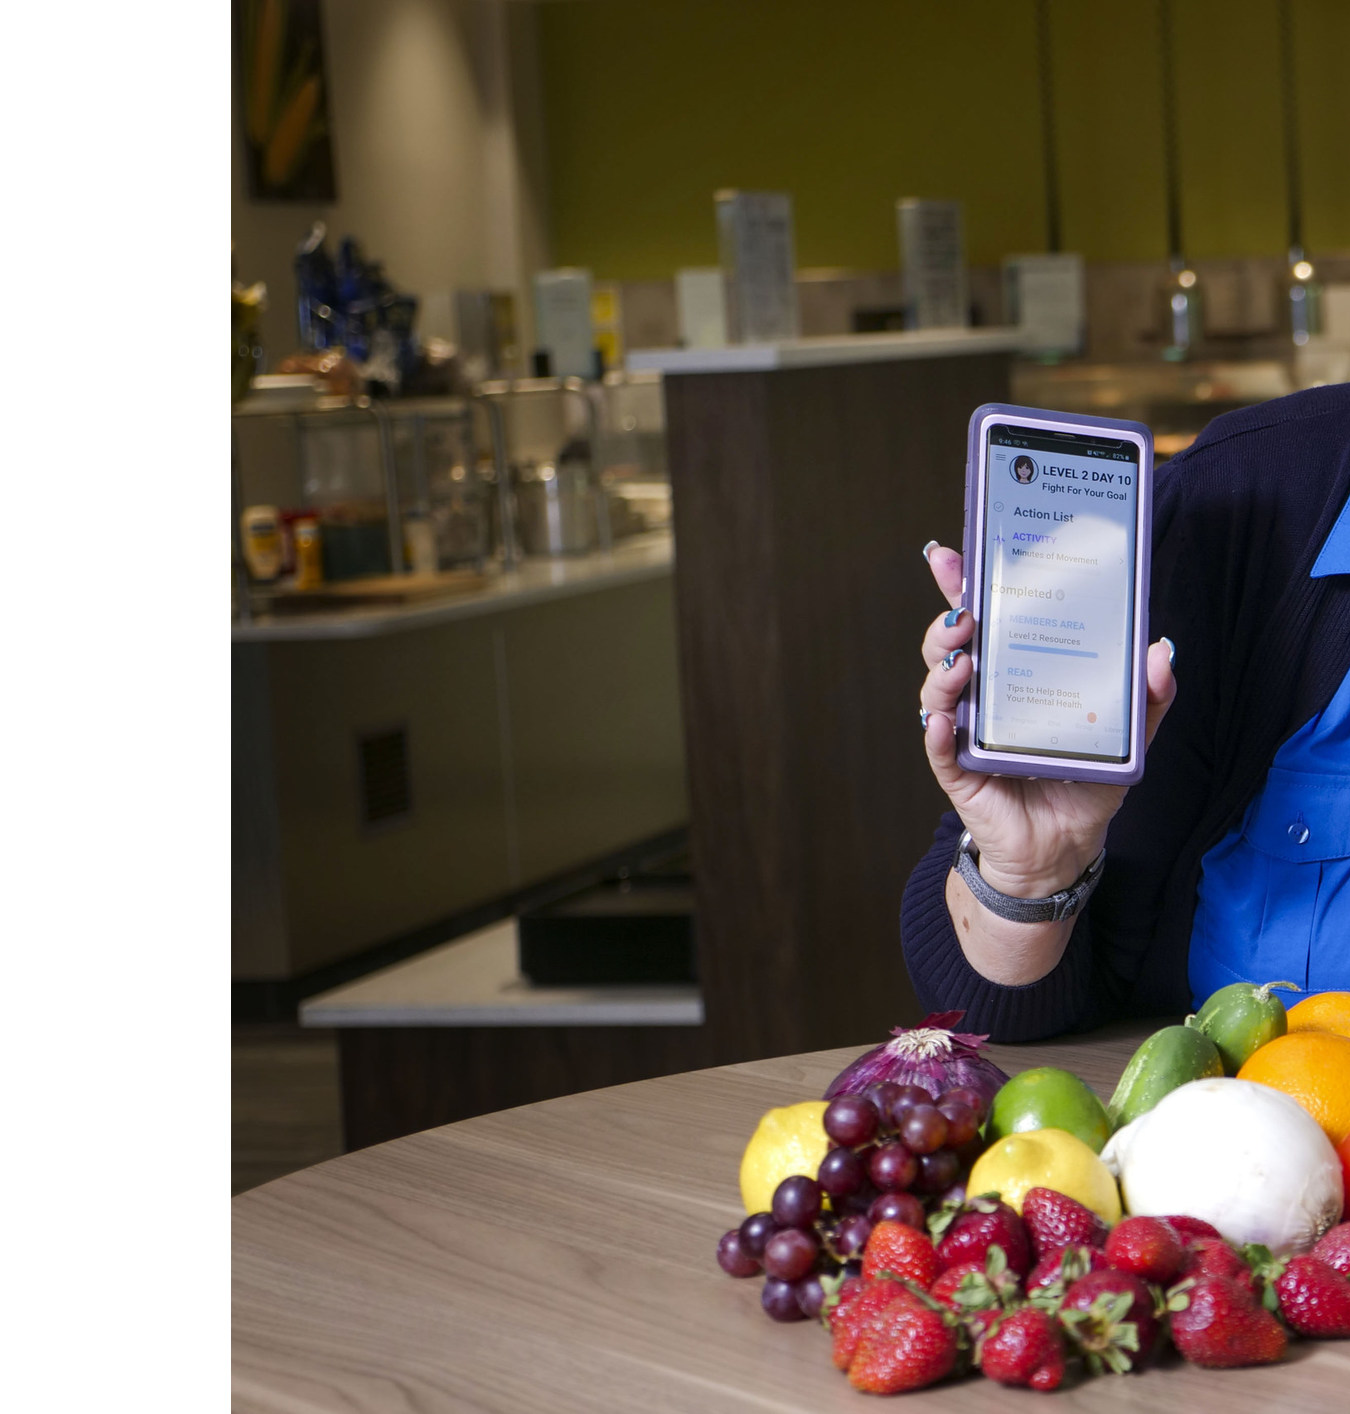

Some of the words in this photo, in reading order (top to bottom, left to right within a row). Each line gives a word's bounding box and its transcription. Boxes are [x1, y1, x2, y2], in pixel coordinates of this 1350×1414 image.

[1043, 465, 1078, 479] LEVEL
[1082, 470, 1089, 480] 2
[1092, 472, 1114, 483] DAY
[1118, 475, 1131, 485] 10
[1042, 482, 1065, 494] Fight
[1067, 486, 1082, 495] For
[1084, 488, 1104, 498] Your
[1107, 491, 1127, 501] Goal
[1014, 507, 1050, 520] Action
[1054, 511, 1074, 523] List
[1012, 532, 1057, 544] ACTIVITY
[1012, 548, 1044, 559] Minutes
[1047, 552, 1054, 560] of
[1056, 553, 1098, 565] Movement
[991, 583, 1052, 600] Completed
[1009, 615, 1057, 627] MEMBERS
[1060, 620, 1085, 631] AREA
[1009, 631, 1030, 640] Level
[1040, 634, 1081, 646] Resources
[1007, 667, 1033, 678] READ
[1007, 683, 1024, 693] Tips
[1026, 685, 1034, 694] to
[1036, 686, 1055, 696] Help
[1056, 689, 1080, 699] Boost
[1006, 694, 1025, 703] Your
[1027, 697, 1055, 706] Mental
[1056, 699, 1082, 709] Health
